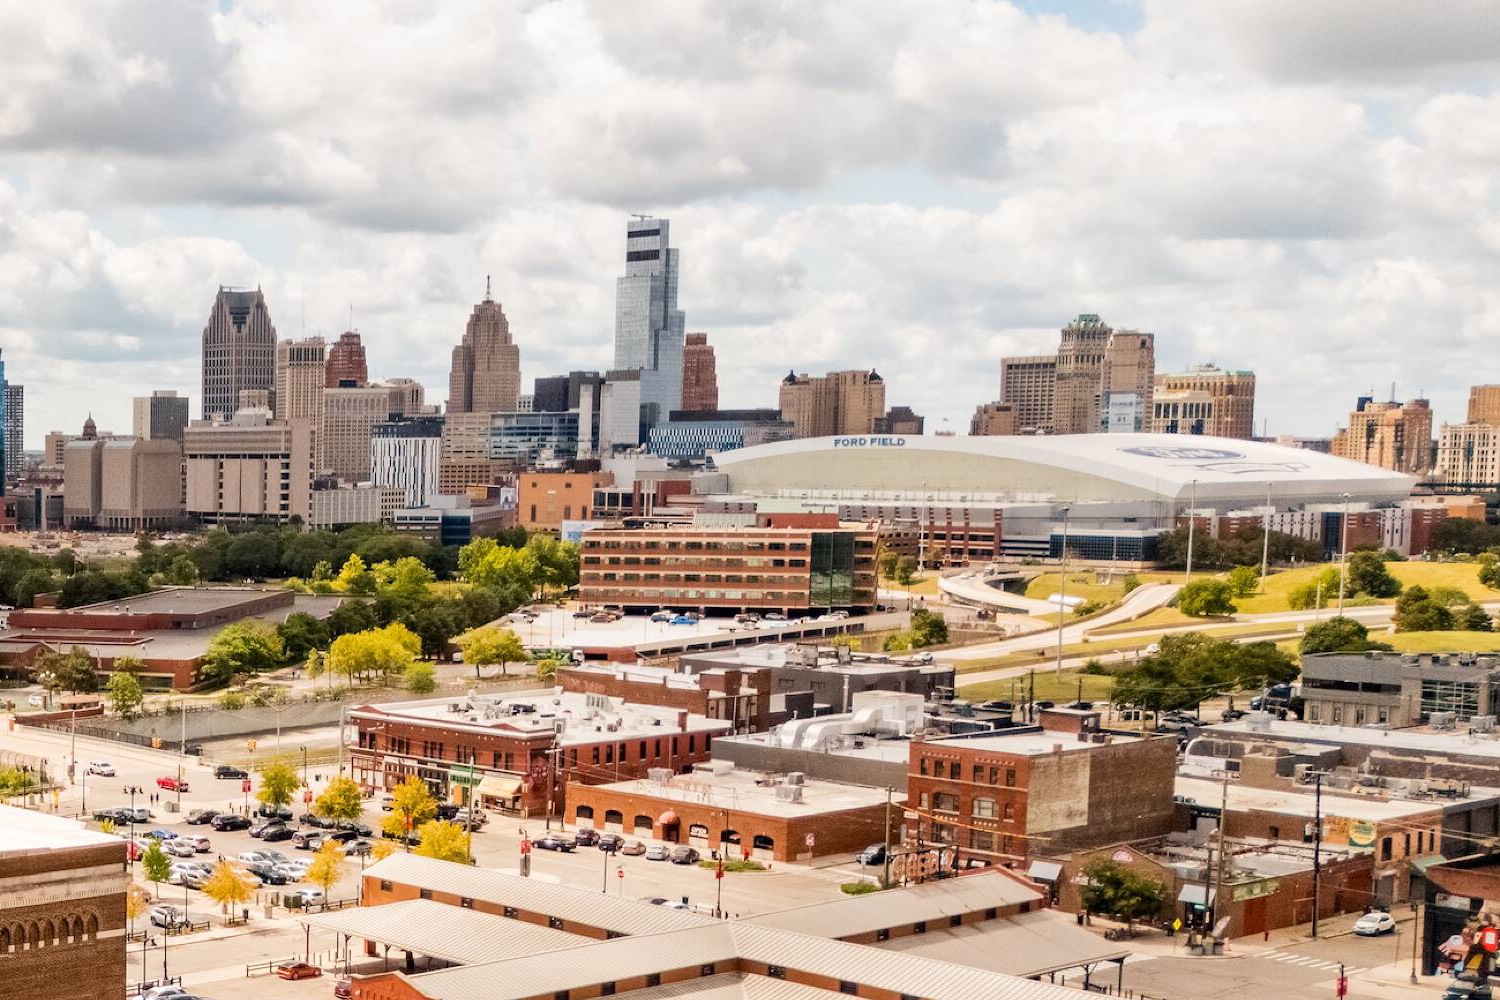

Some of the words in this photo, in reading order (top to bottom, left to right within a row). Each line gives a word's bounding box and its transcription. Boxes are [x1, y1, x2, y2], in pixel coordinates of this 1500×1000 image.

[834, 438, 867, 447] FORD
[870, 438, 905, 446] FIELD
[644, 521, 665, 530] Crain
